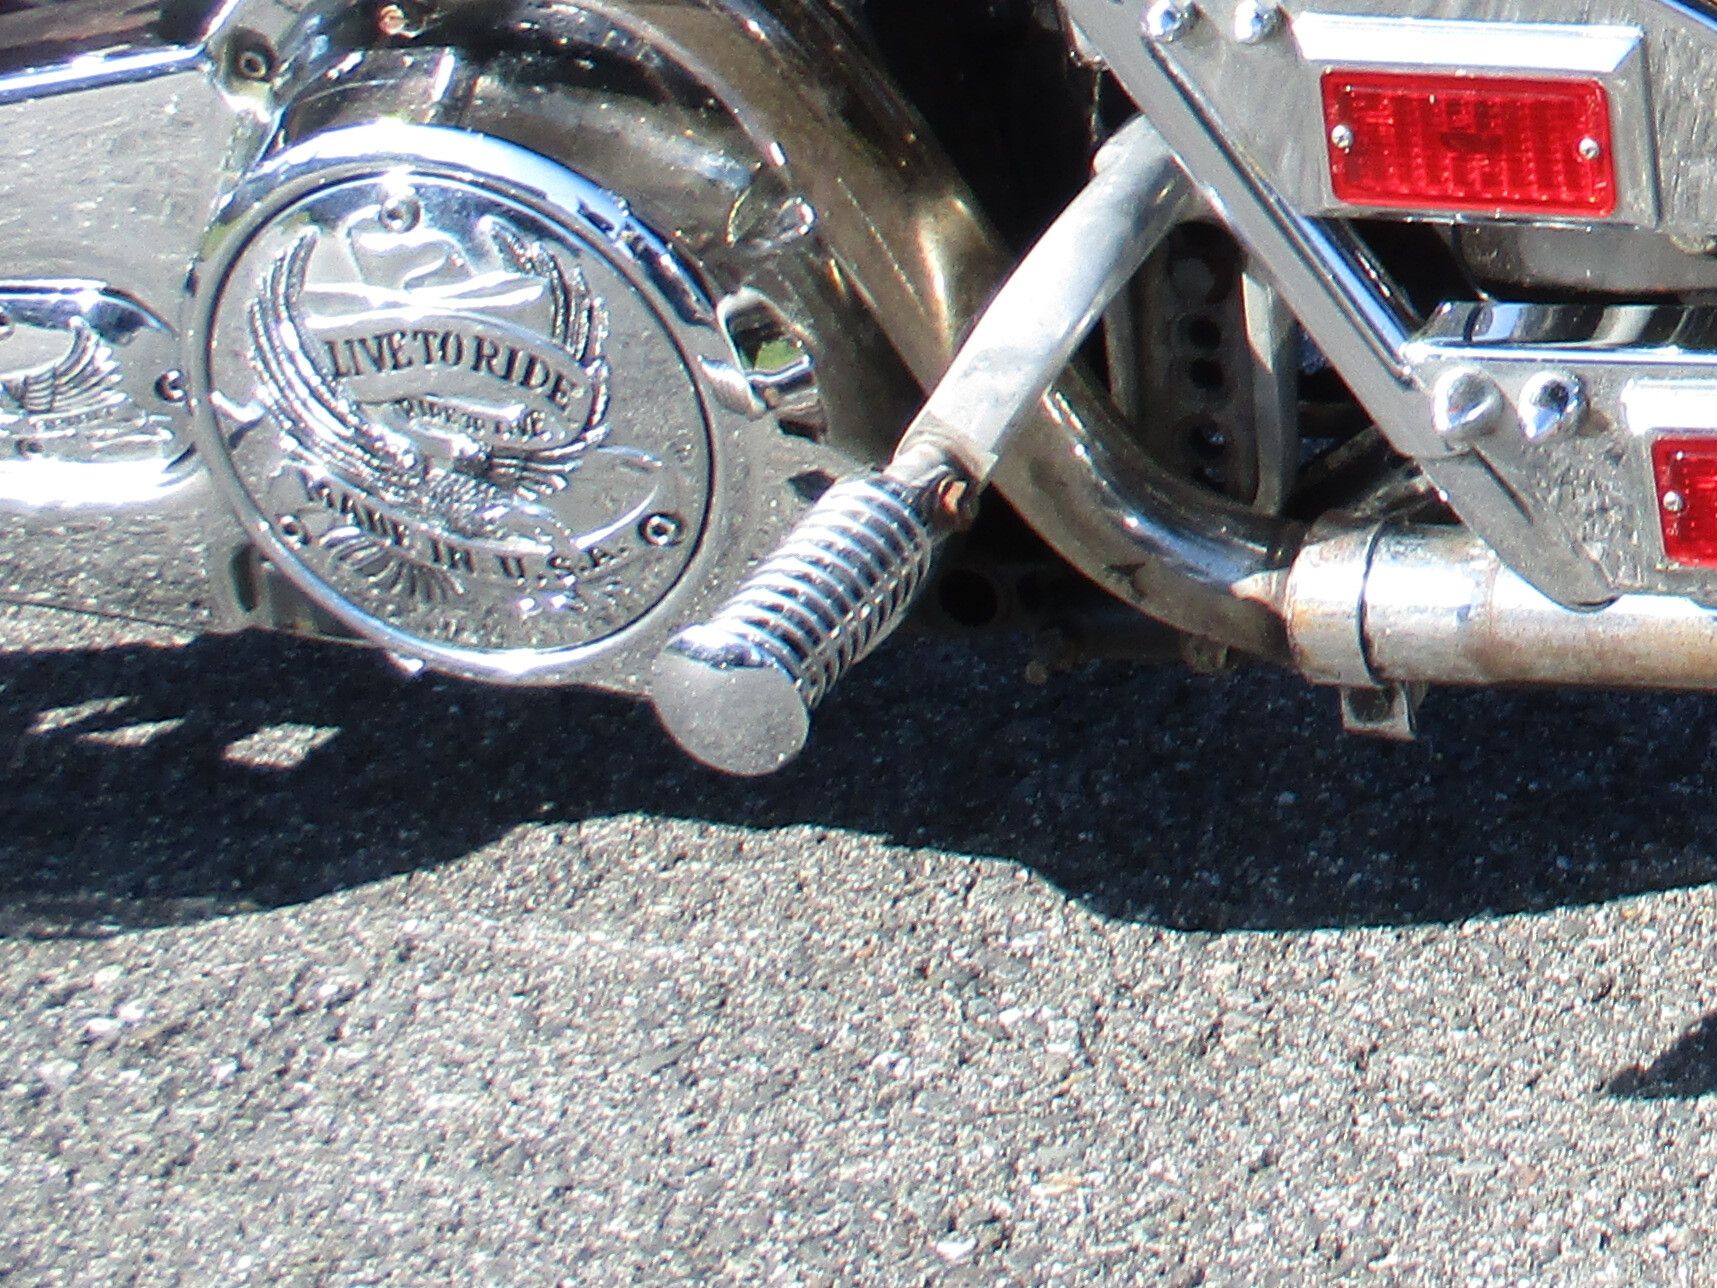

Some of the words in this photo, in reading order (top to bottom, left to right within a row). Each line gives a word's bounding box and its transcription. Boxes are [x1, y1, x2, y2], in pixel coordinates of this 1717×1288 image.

[324, 329, 412, 377] LIVE
[412, 328, 465, 369] TO
[470, 334, 582, 410] RIDE
[303, 474, 410, 548] MADE
[430, 537, 478, 575] IN
